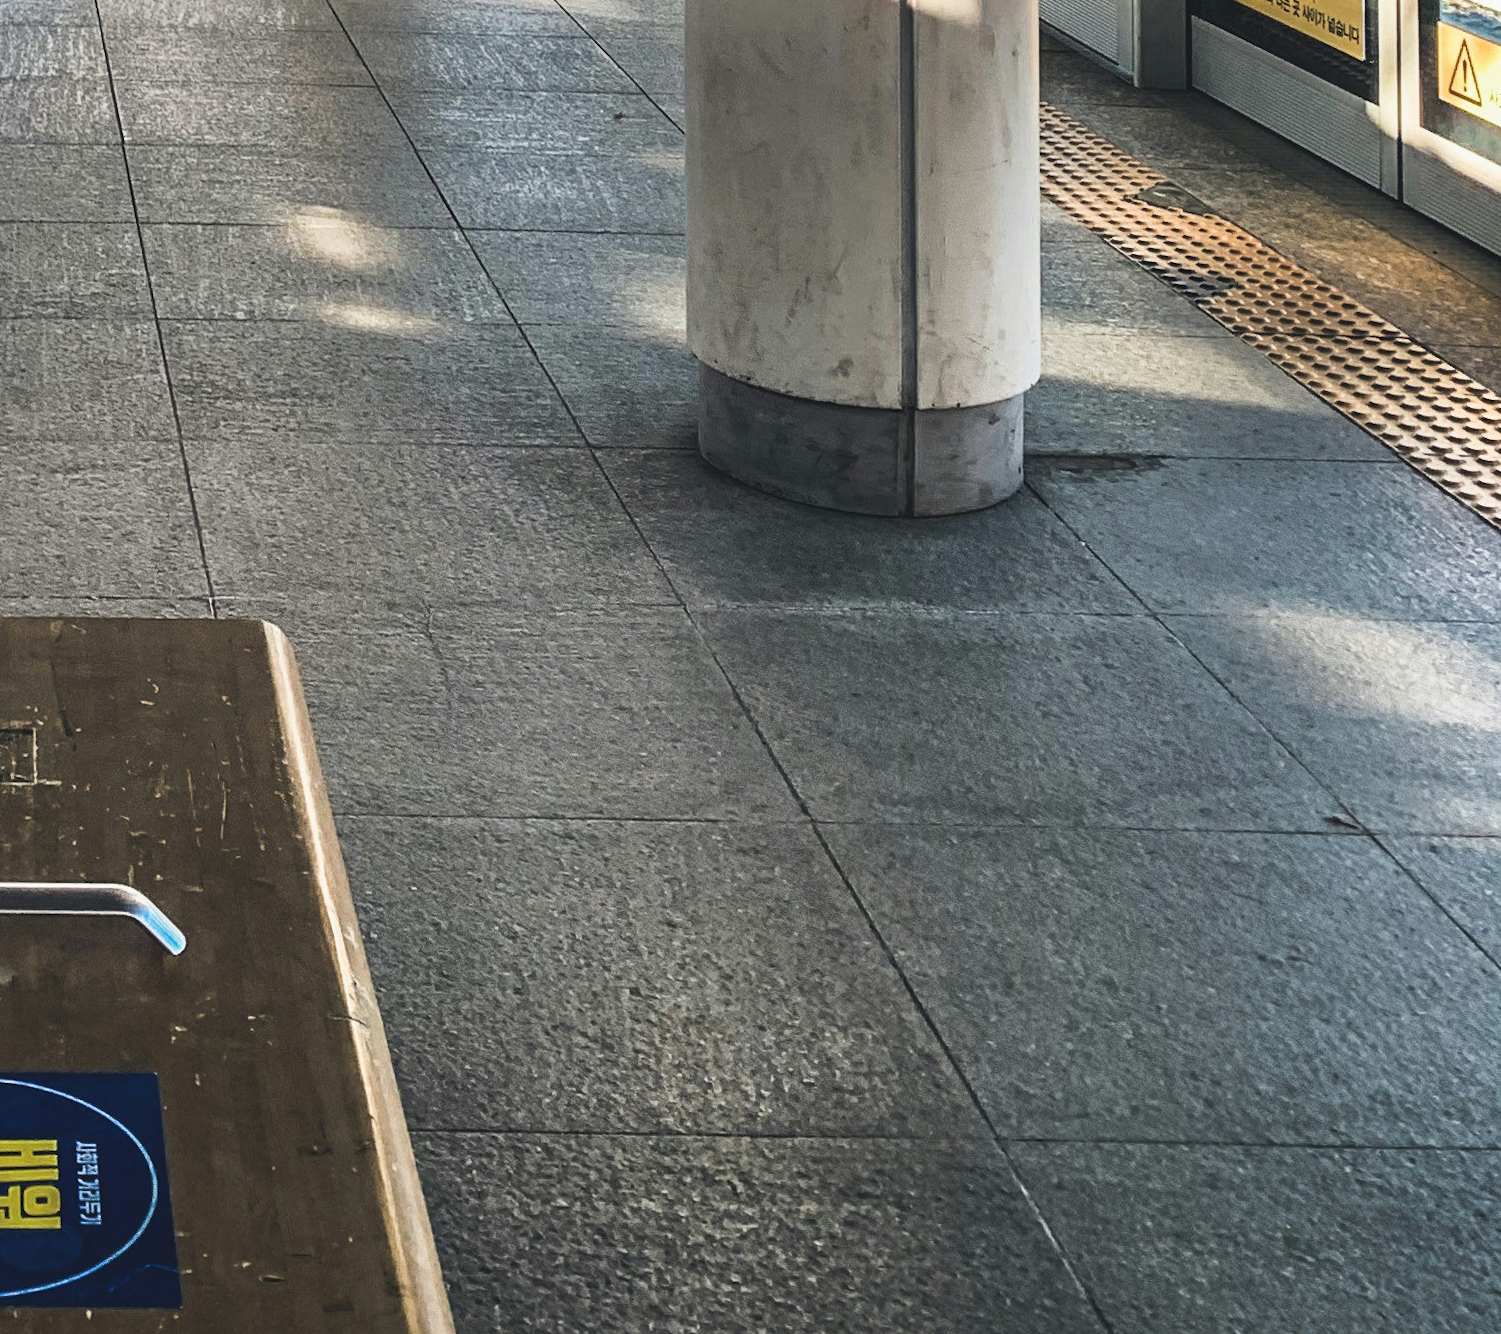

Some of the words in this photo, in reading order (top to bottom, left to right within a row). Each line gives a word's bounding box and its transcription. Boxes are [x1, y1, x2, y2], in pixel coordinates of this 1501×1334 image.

[1293, 0, 1300, 17] 곳
[1302, 6, 1326, 29] 사이가
[1327, 15, 1360, 45] 넓습니다
[75, 1140, 99, 1176] 사회적
[77, 1178, 102, 1226] 거리두기
